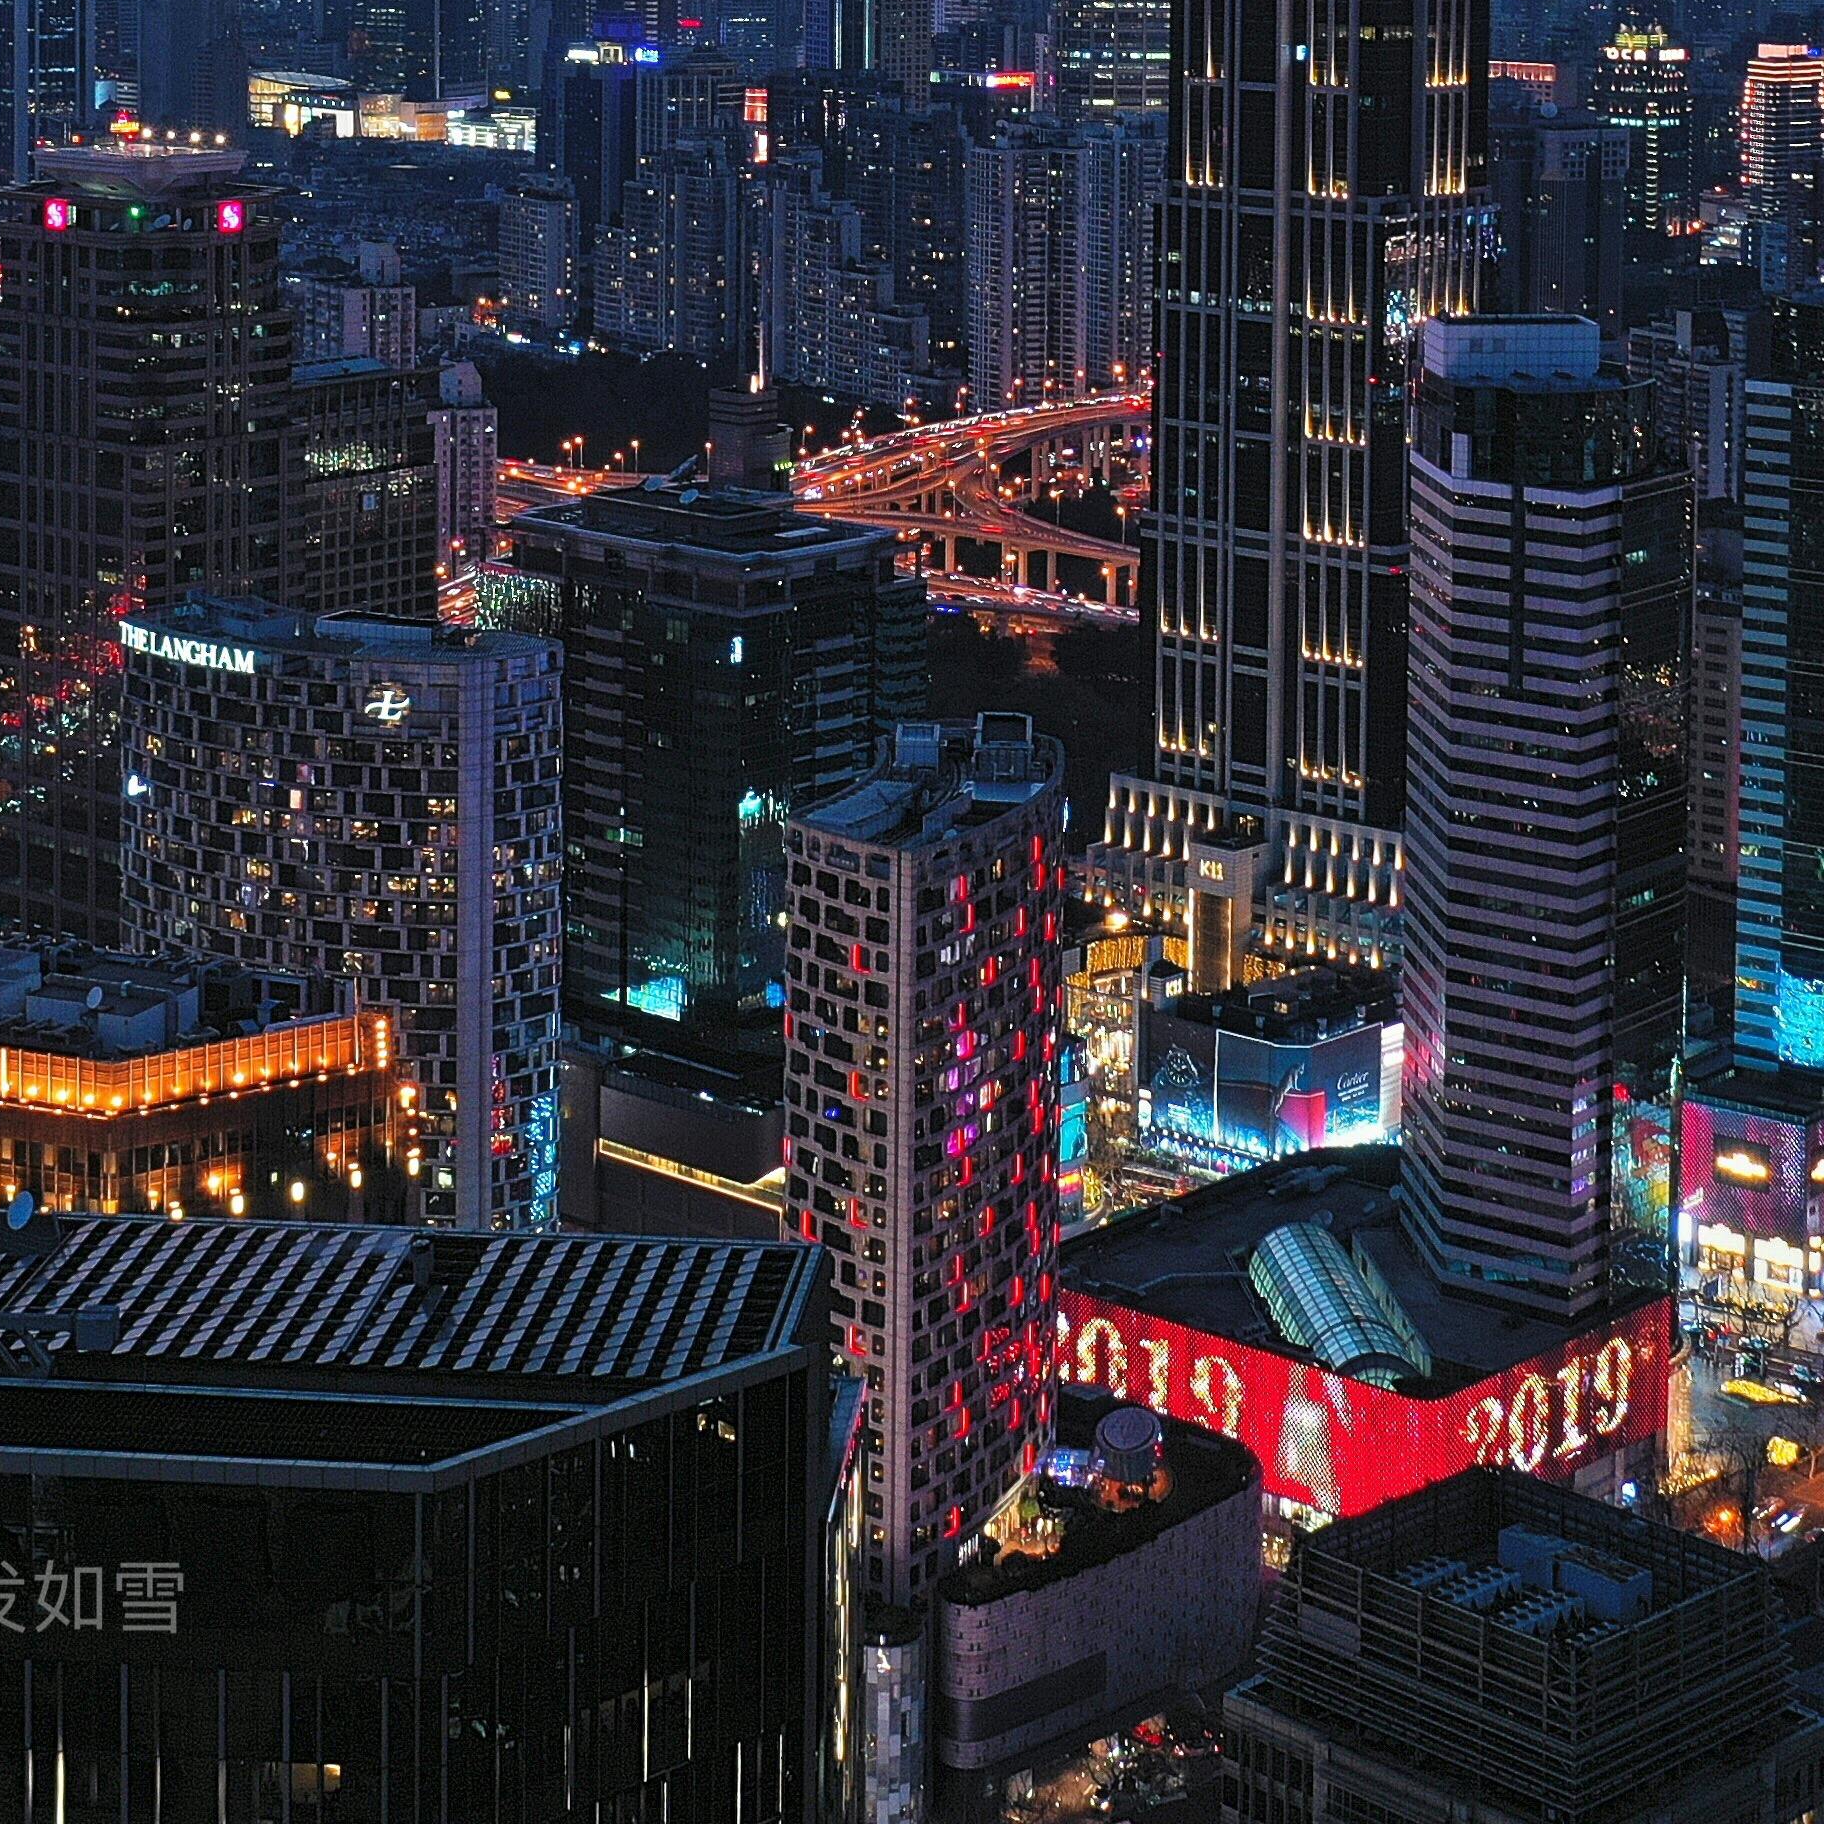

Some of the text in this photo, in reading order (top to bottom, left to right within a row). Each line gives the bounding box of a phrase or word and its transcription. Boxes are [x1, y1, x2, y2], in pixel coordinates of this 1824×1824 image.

[118, 621, 255, 674] THE LANGHAM
[1200, 858, 1224, 881] K11
[1337, 1071, 1369, 1091] Cartier
[1458, 1336, 1633, 1472] 2019
